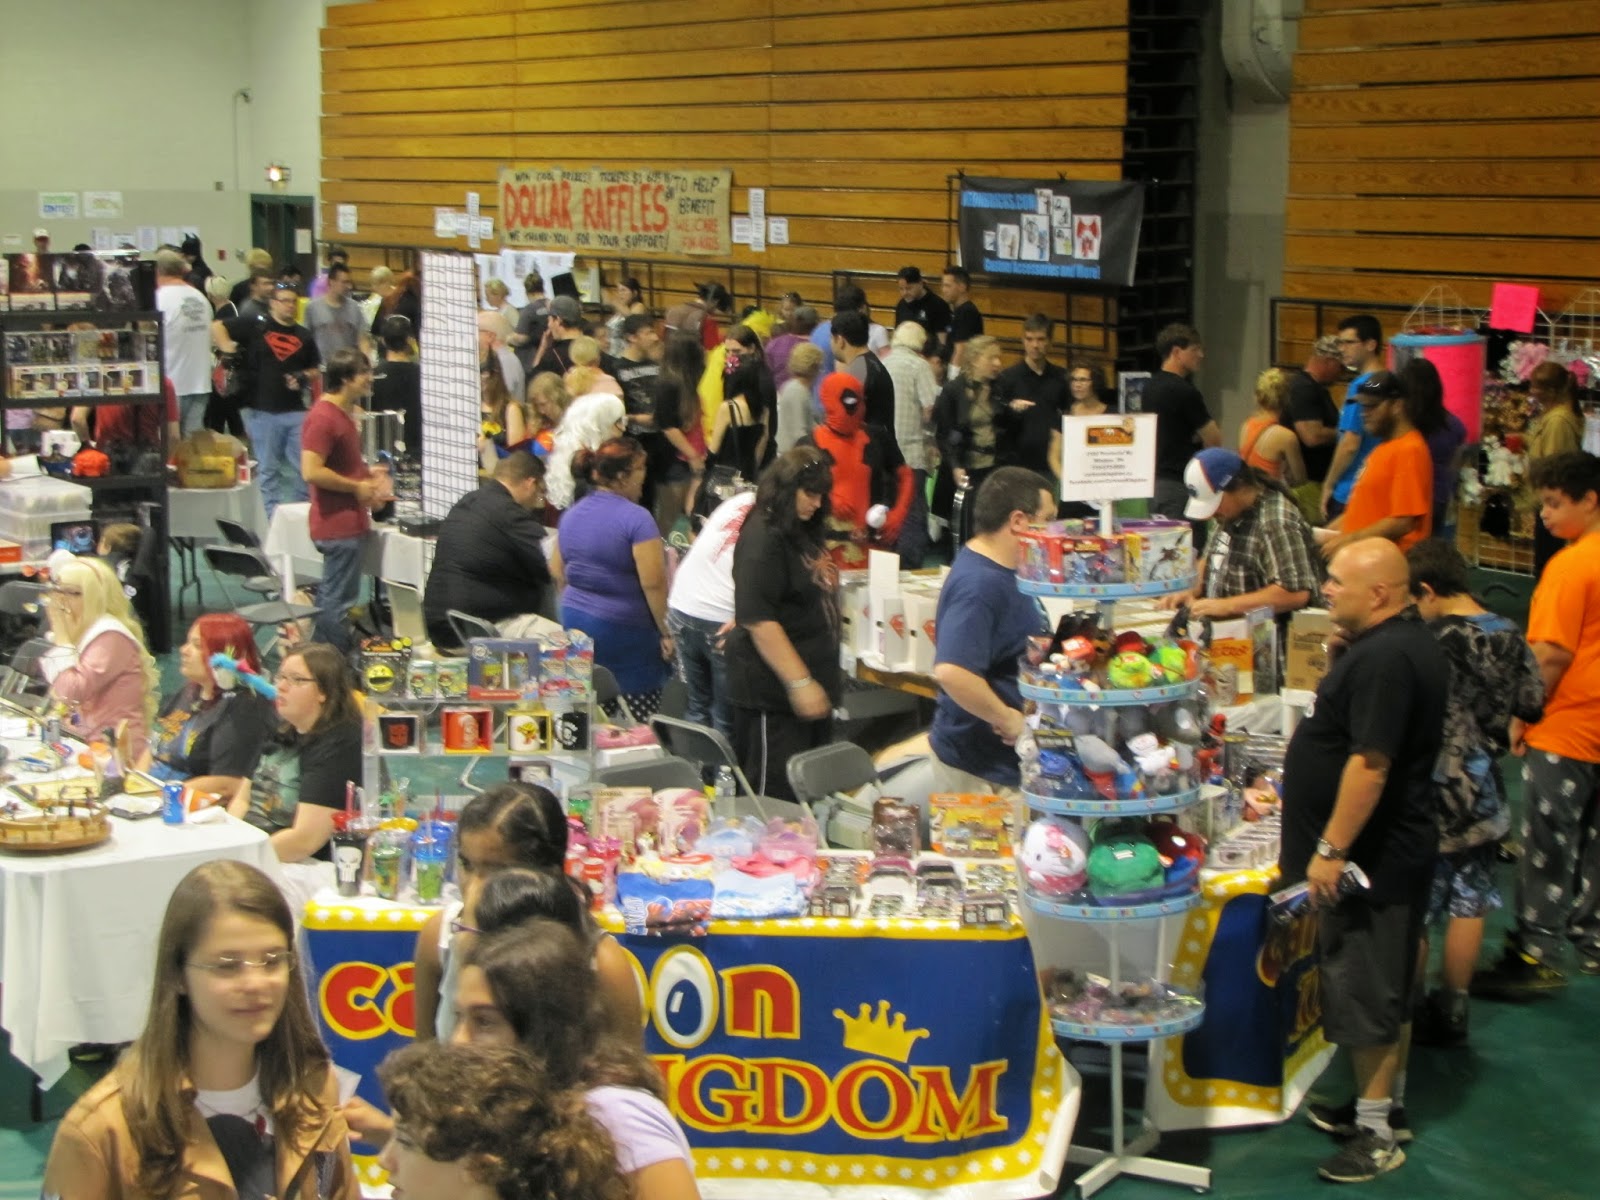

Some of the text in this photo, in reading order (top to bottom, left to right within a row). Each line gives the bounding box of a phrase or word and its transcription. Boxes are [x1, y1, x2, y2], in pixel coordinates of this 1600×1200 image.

[693, 176, 720, 194] HELP
[503, 180, 670, 234] DOLLAR RAFFLES
[679, 197, 716, 216] BENEFIT
[597, 233, 620, 247] YOUR
